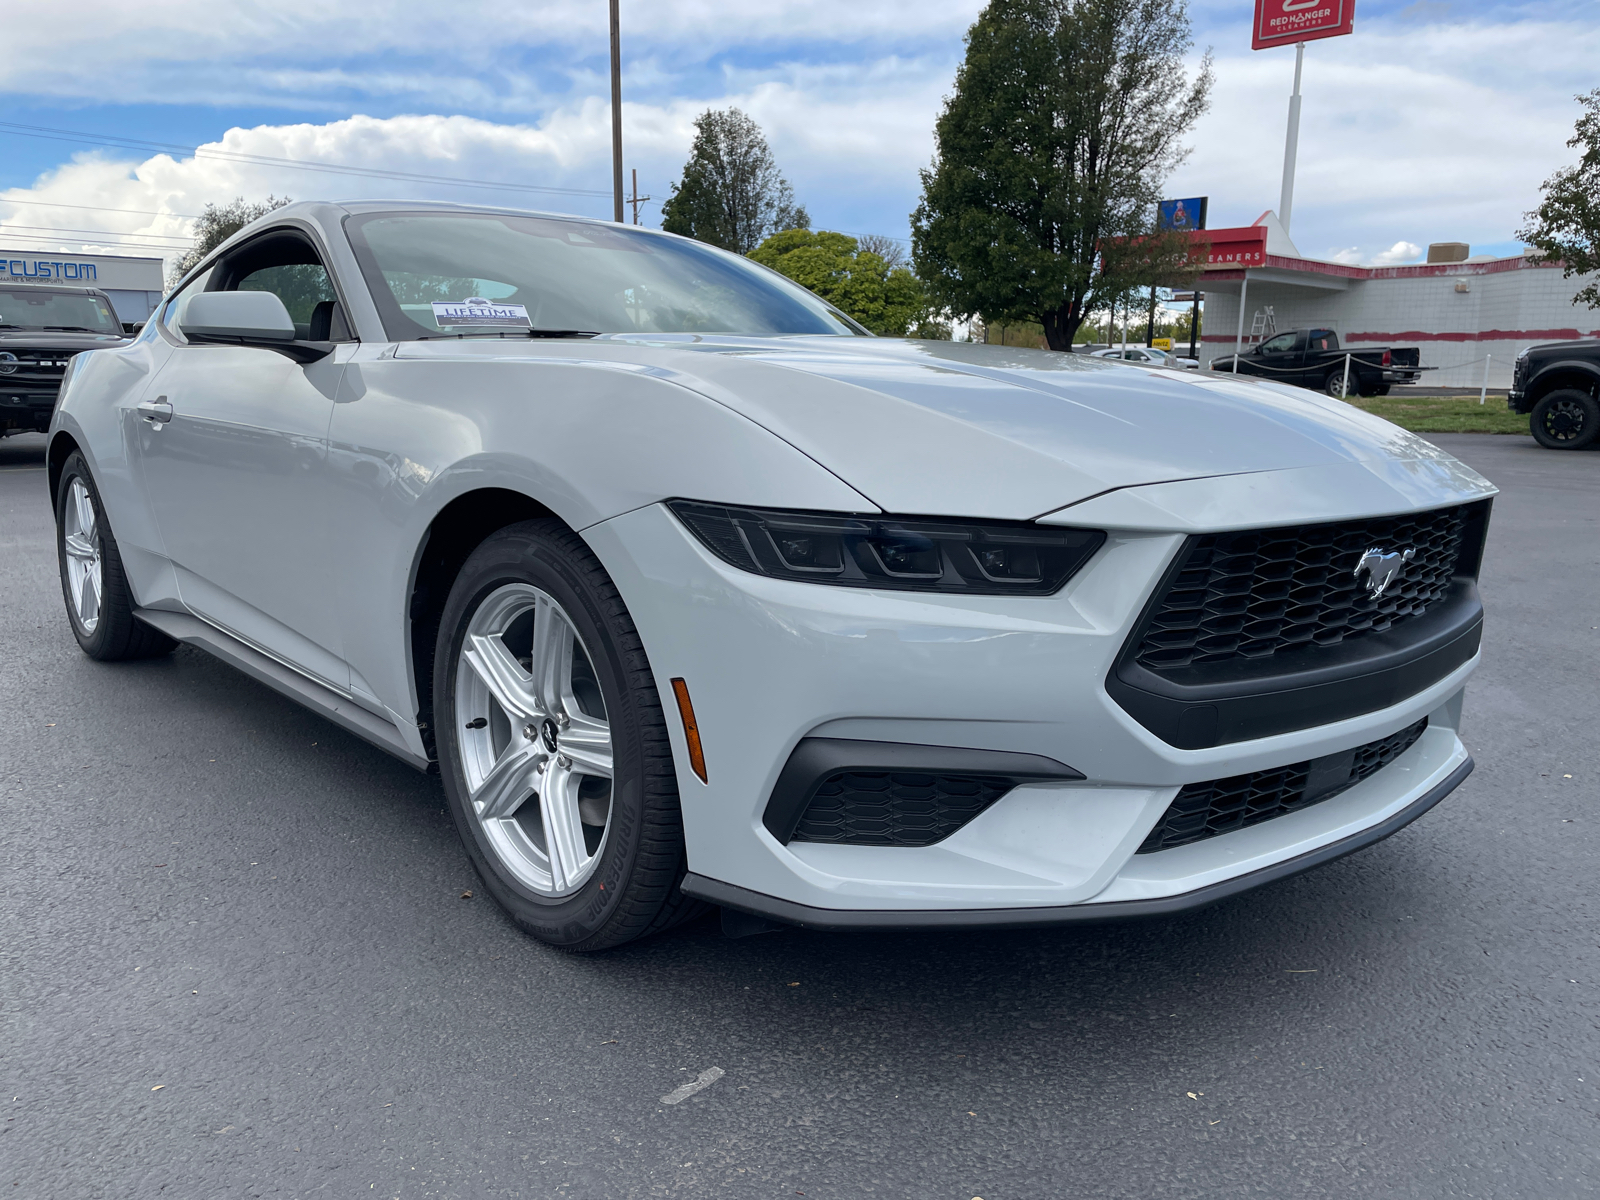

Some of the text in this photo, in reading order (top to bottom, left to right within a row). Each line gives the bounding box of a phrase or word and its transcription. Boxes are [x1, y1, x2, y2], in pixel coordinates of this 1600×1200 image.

[1270, 8, 1331, 27] RED HANGER
[1277, 18, 1322, 31] CLEANERS
[1191, 252, 1260, 263] CEANERS
[445, 308, 517, 317] LIFETIME
[586, 804, 635, 922] BRIDGESTONE
